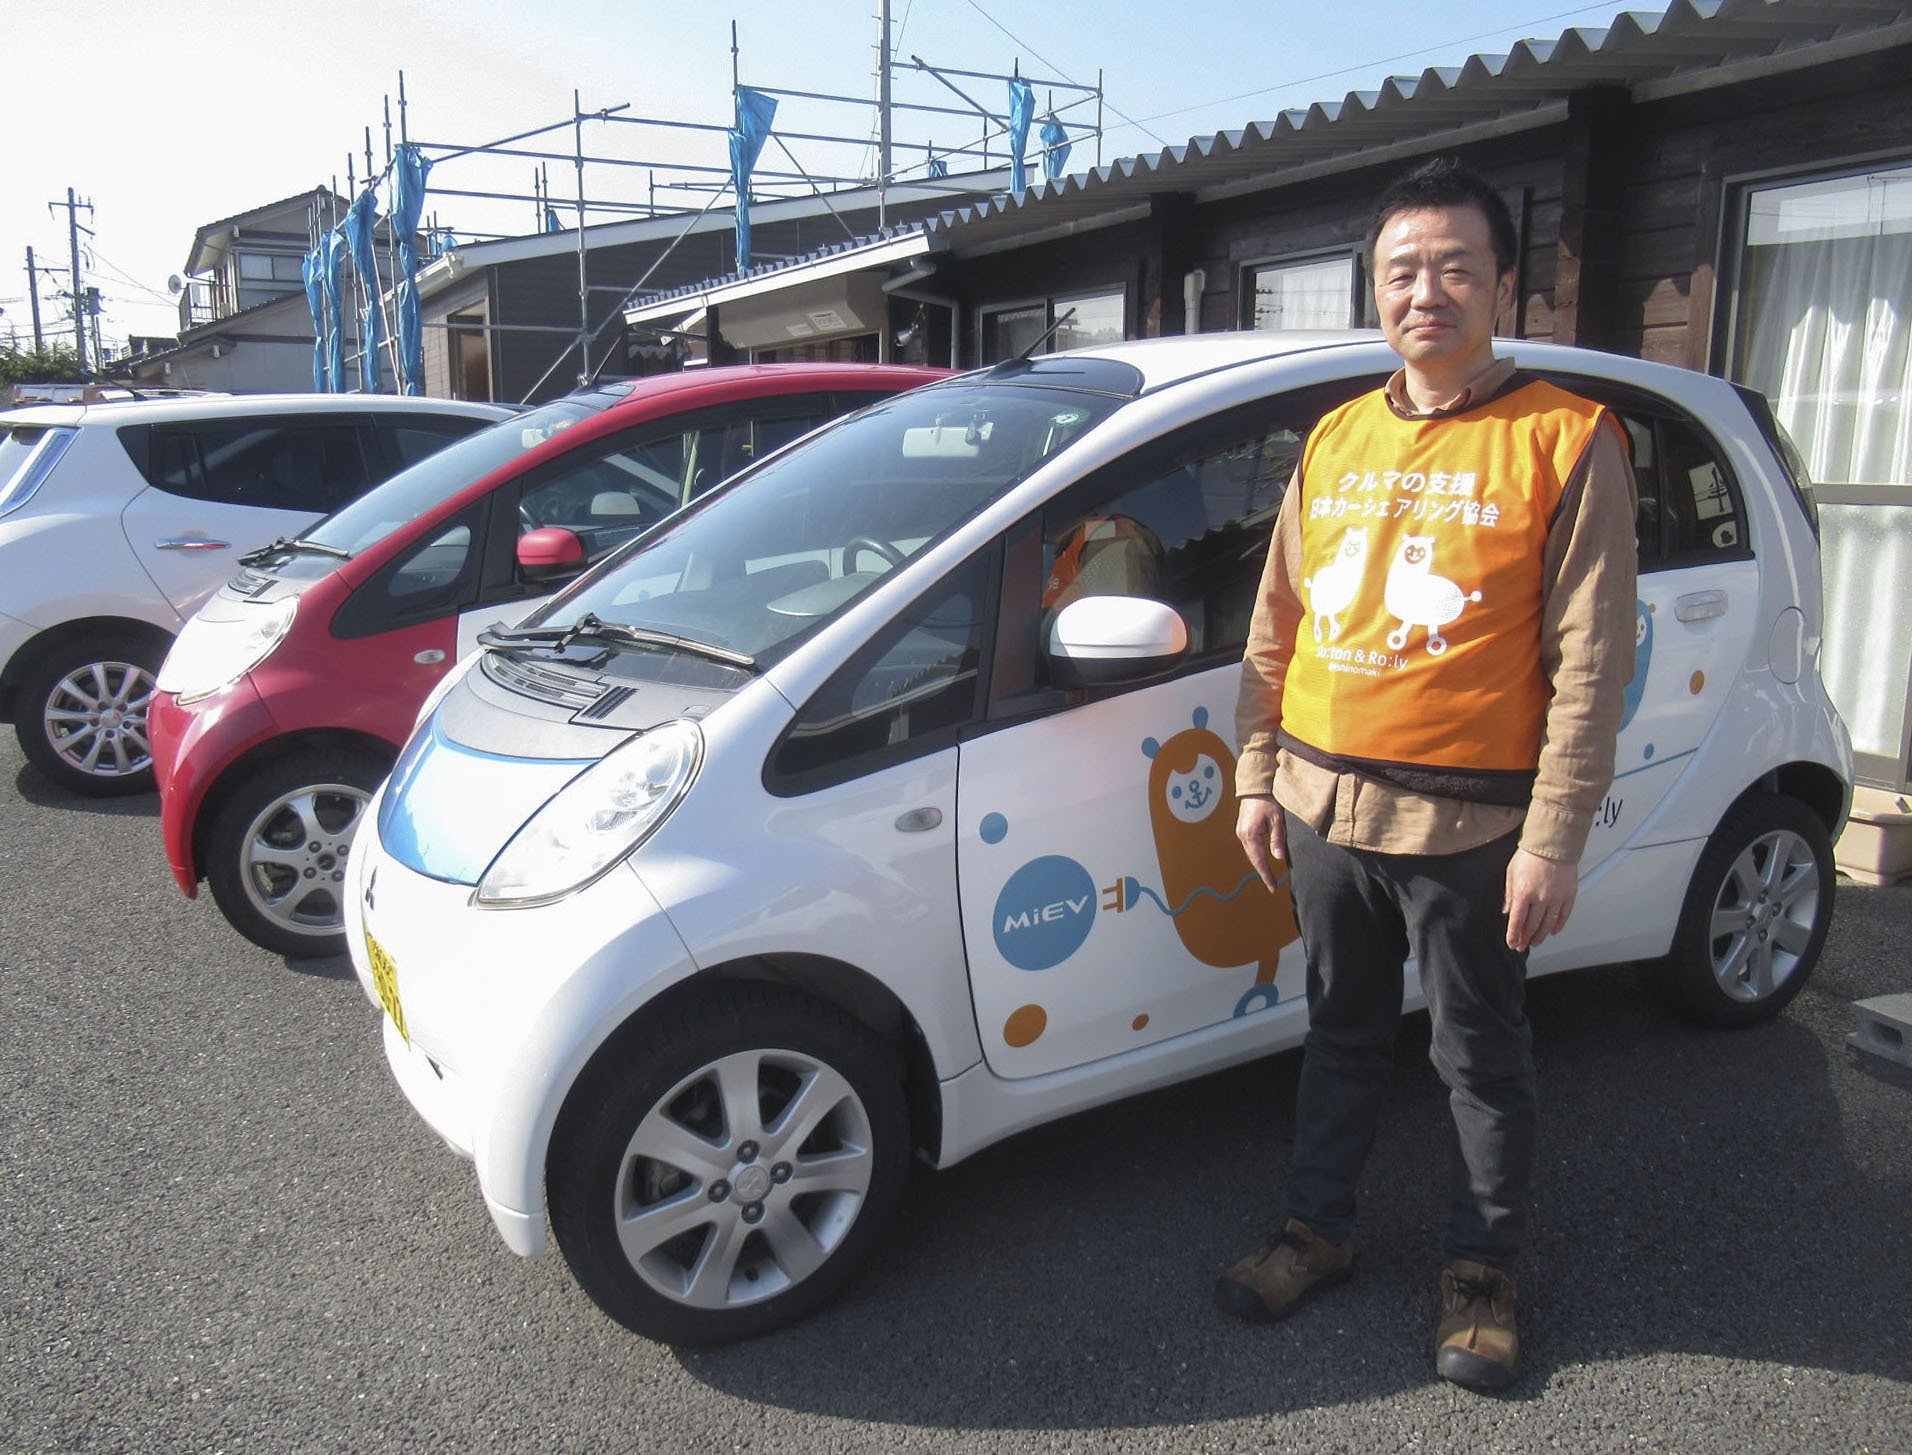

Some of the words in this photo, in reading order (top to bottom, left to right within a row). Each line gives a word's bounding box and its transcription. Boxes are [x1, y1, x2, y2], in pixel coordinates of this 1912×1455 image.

[1338, 470, 1478, 496] クルマの支援
[1354, 648, 1365, 663] &
[1367, 650, 1409, 672] Ro:ly
[1002, 894, 1089, 934] MiEV
